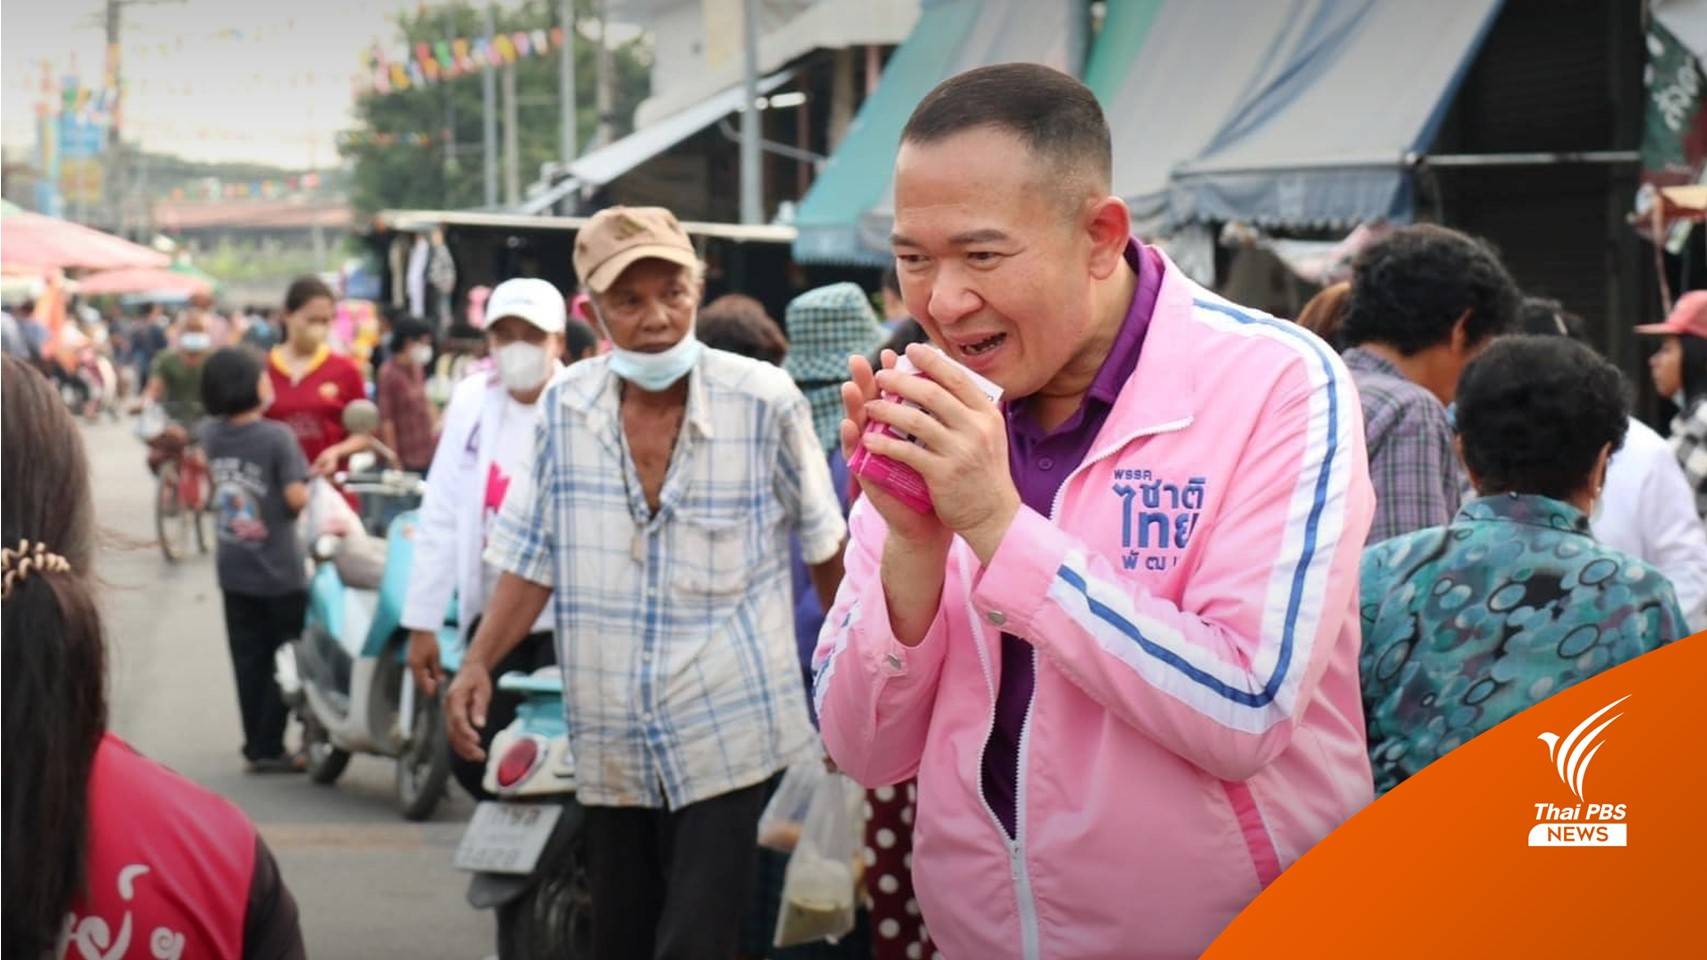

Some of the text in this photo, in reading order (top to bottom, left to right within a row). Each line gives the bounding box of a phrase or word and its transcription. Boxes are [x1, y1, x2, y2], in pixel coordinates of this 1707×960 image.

[1114, 469, 1152, 480] พรรค
[1139, 478, 1206, 509] ชาติ
[1112, 483, 1199, 549] ไทย
